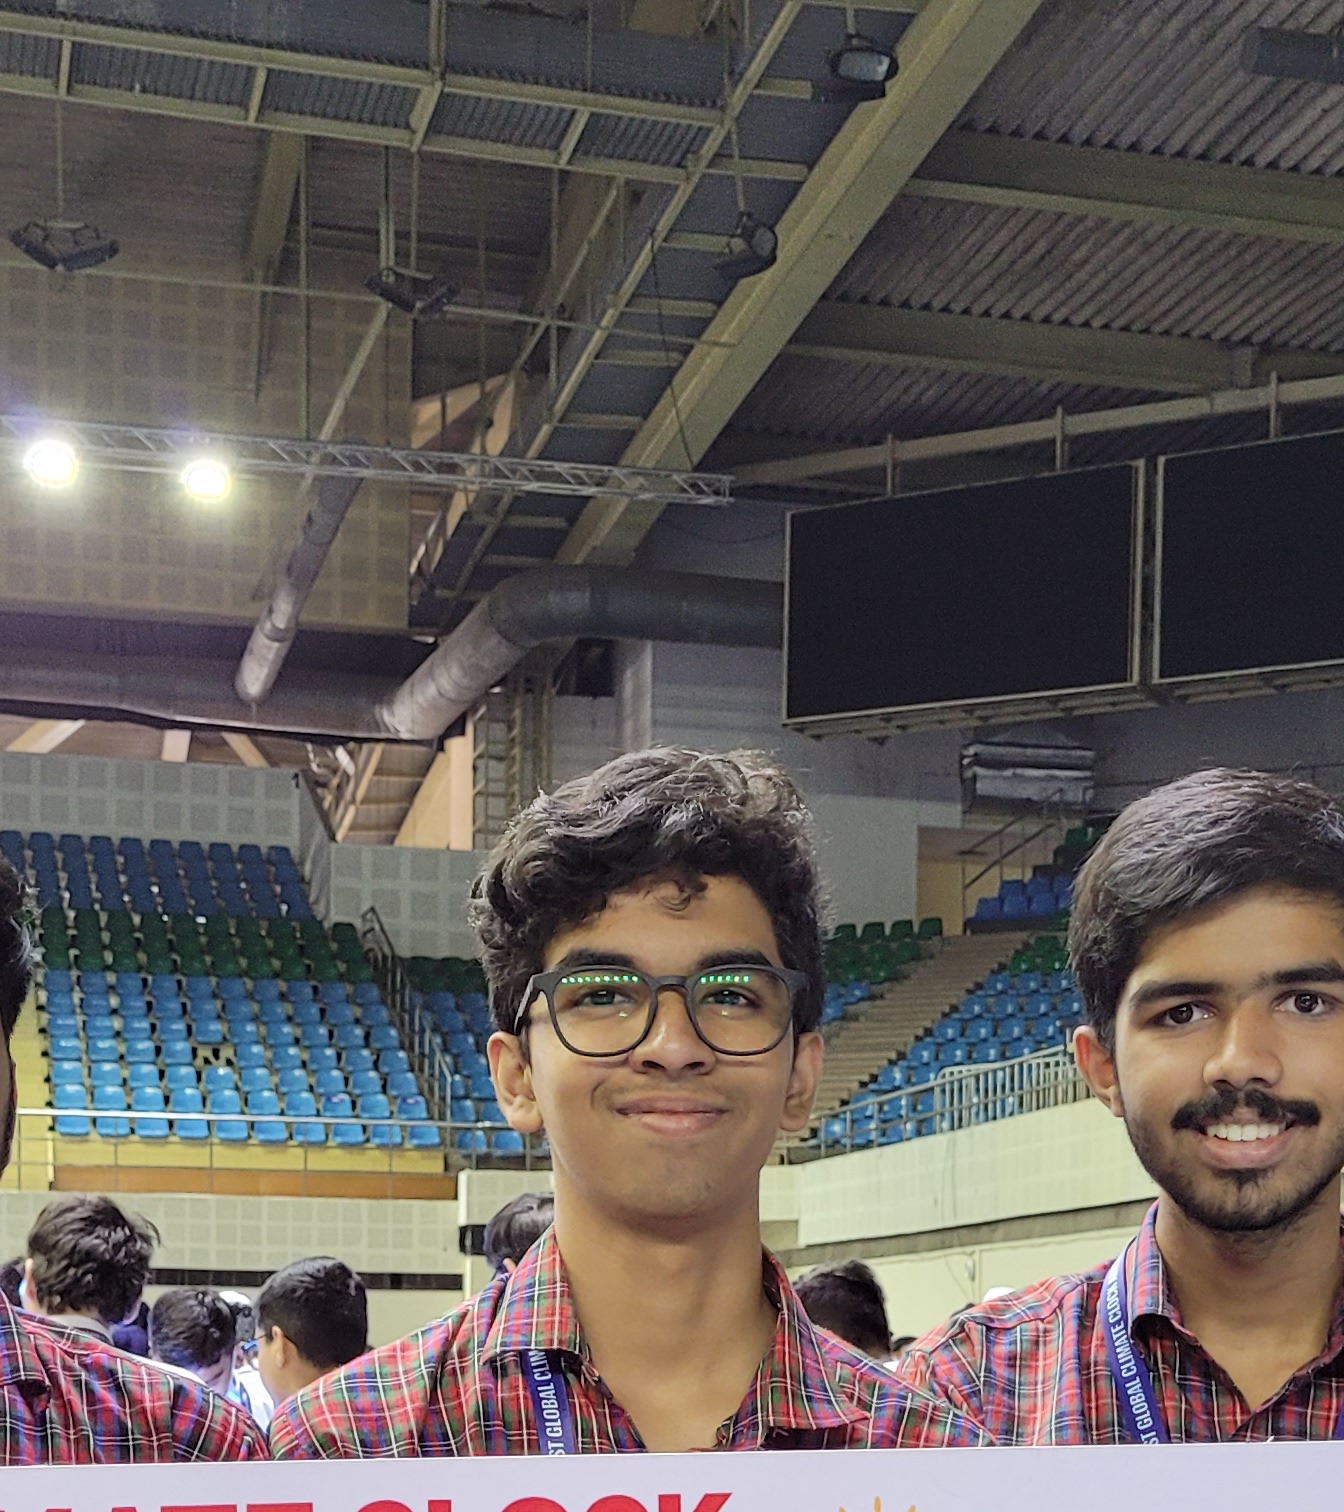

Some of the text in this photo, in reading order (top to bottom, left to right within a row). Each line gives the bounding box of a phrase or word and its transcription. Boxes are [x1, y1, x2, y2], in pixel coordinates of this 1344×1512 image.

[1110, 1320, 1137, 1378] CLIMATE
[537, 1382, 563, 1437] GLOBAL
[1125, 1375, 1154, 1431] GLOBAL
